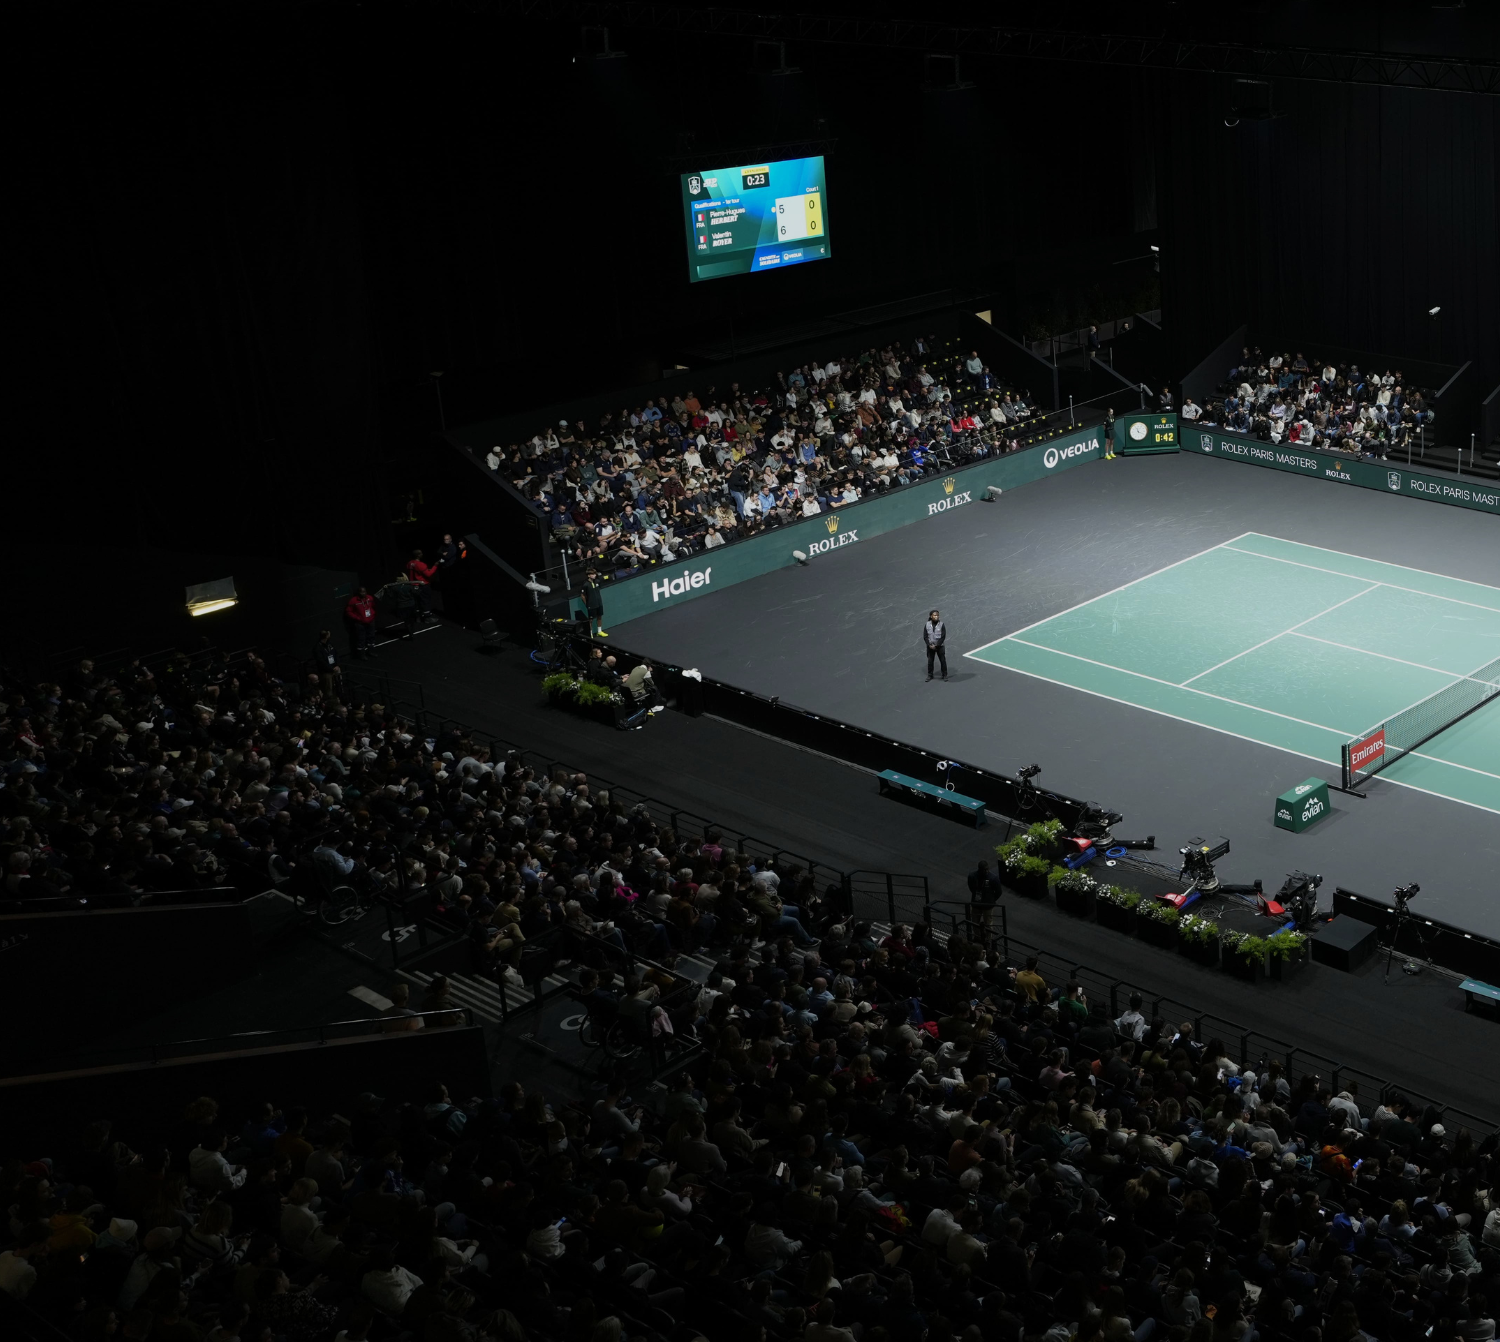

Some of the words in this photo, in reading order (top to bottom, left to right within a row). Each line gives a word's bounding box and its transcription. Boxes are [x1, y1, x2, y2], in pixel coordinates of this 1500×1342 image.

[747, 175, 765, 186] 0:23
[779, 205, 784, 214] 5
[809, 200, 814, 209] 0
[710, 208, 745, 217] Pierre-Hugues
[711, 215, 738, 225] HERBERT
[781, 226, 786, 235] 6
[811, 221, 816, 230] 0
[712, 231, 732, 239] Valentin
[713, 238, 732, 247] ROYER
[1155, 433, 1173, 442] 0:42
[1059, 438, 1099, 460] VEOLIA
[1222, 442, 1248, 456] ROLEX
[1251, 448, 1274, 460] PARIS
[1277, 453, 1317, 469] MASTERS
[1326, 470, 1351, 480] ROLEX
[1410, 480, 1441, 494] ROLEX
[1444, 486, 1470, 500] PARIS
[928, 491, 972, 516] ROLEX
[809, 530, 858, 556] ROLEX
[652, 567, 711, 602] Haier
[1352, 739, 1384, 764] Emirates
[1278, 811, 1292, 821] evian
[1302, 802, 1323, 821] evian
